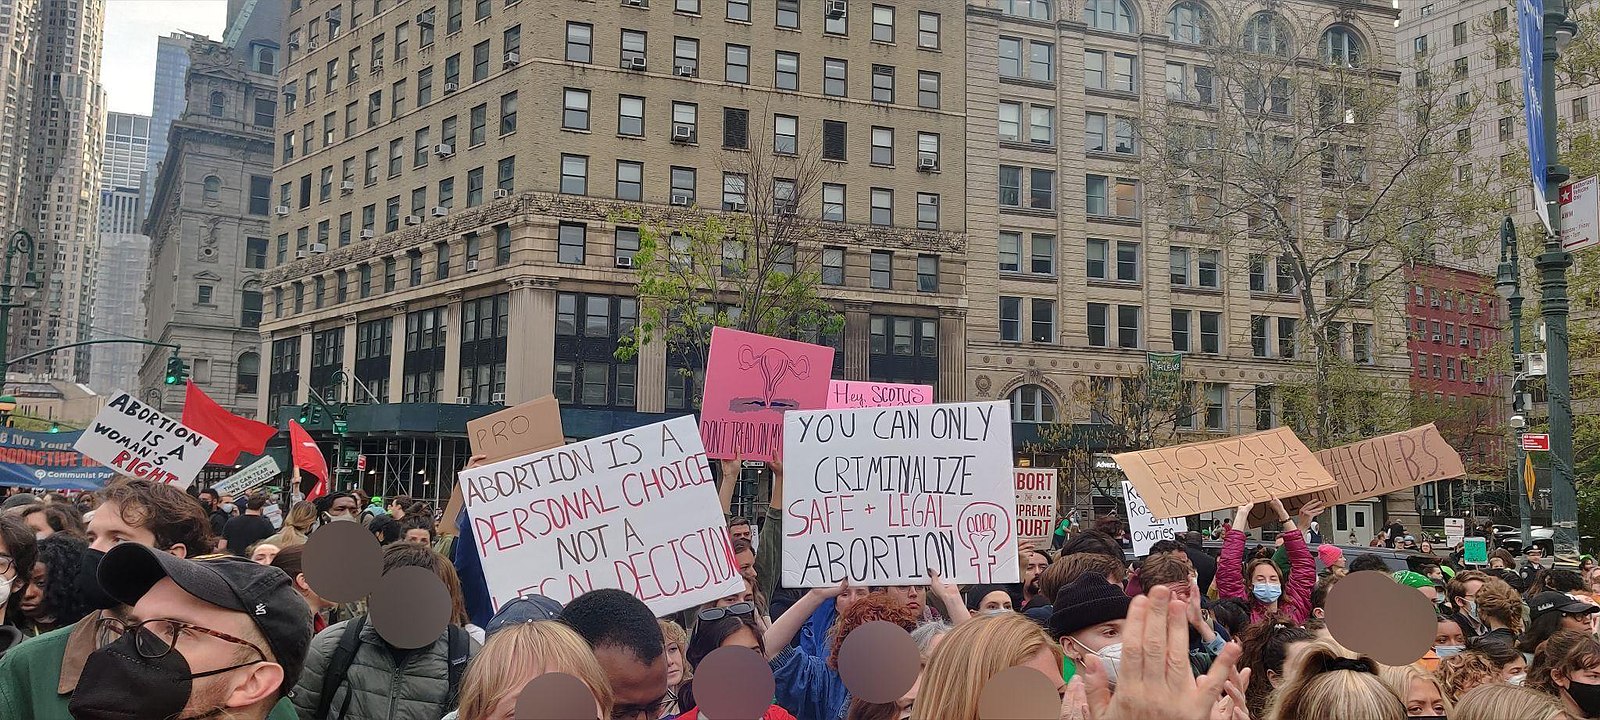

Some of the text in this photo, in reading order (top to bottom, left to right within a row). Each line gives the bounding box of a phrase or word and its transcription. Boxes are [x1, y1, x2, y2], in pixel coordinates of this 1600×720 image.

[872, 385, 924, 404] SCOTUS
[108, 394, 202, 447] ABORTION
[477, 415, 530, 450] PRO
[702, 418, 729, 454] DON'T
[730, 422, 756, 454] TREAD
[758, 422, 769, 456] ON
[799, 405, 993, 443] YOU CAN ONLY
[12, 434, 36, 446] Not
[40, 441, 72, 450] Your
[94, 422, 168, 466] WOMAN'S
[142, 430, 184, 461] IS A
[110, 450, 178, 484] RIGHT
[224, 467, 268, 491] THEY CAN TEAR
[240, 470, 274, 488] CAPITALISM
[467, 423, 684, 507] ABORTION IS A
[814, 456, 976, 496] CRIMINALIZE
[1015, 472, 1053, 490] BORT
[1154, 464, 1254, 493] HANDS
[1254, 454, 1303, 476] OFF
[474, 452, 714, 558] PERSONAL CHOICE
[1016, 504, 1052, 517] PREME
[1161, 490, 1202, 516] MY
[1210, 472, 1320, 506] UTERUS
[787, 495, 854, 536] SAFE
[888, 492, 952, 528] LEGAL
[1016, 519, 1051, 536] OURT
[557, 518, 644, 570] NOT A
[1134, 527, 1174, 542] ovaries
[614, 525, 740, 600] DECISION
[800, 530, 957, 585] ABORTION
